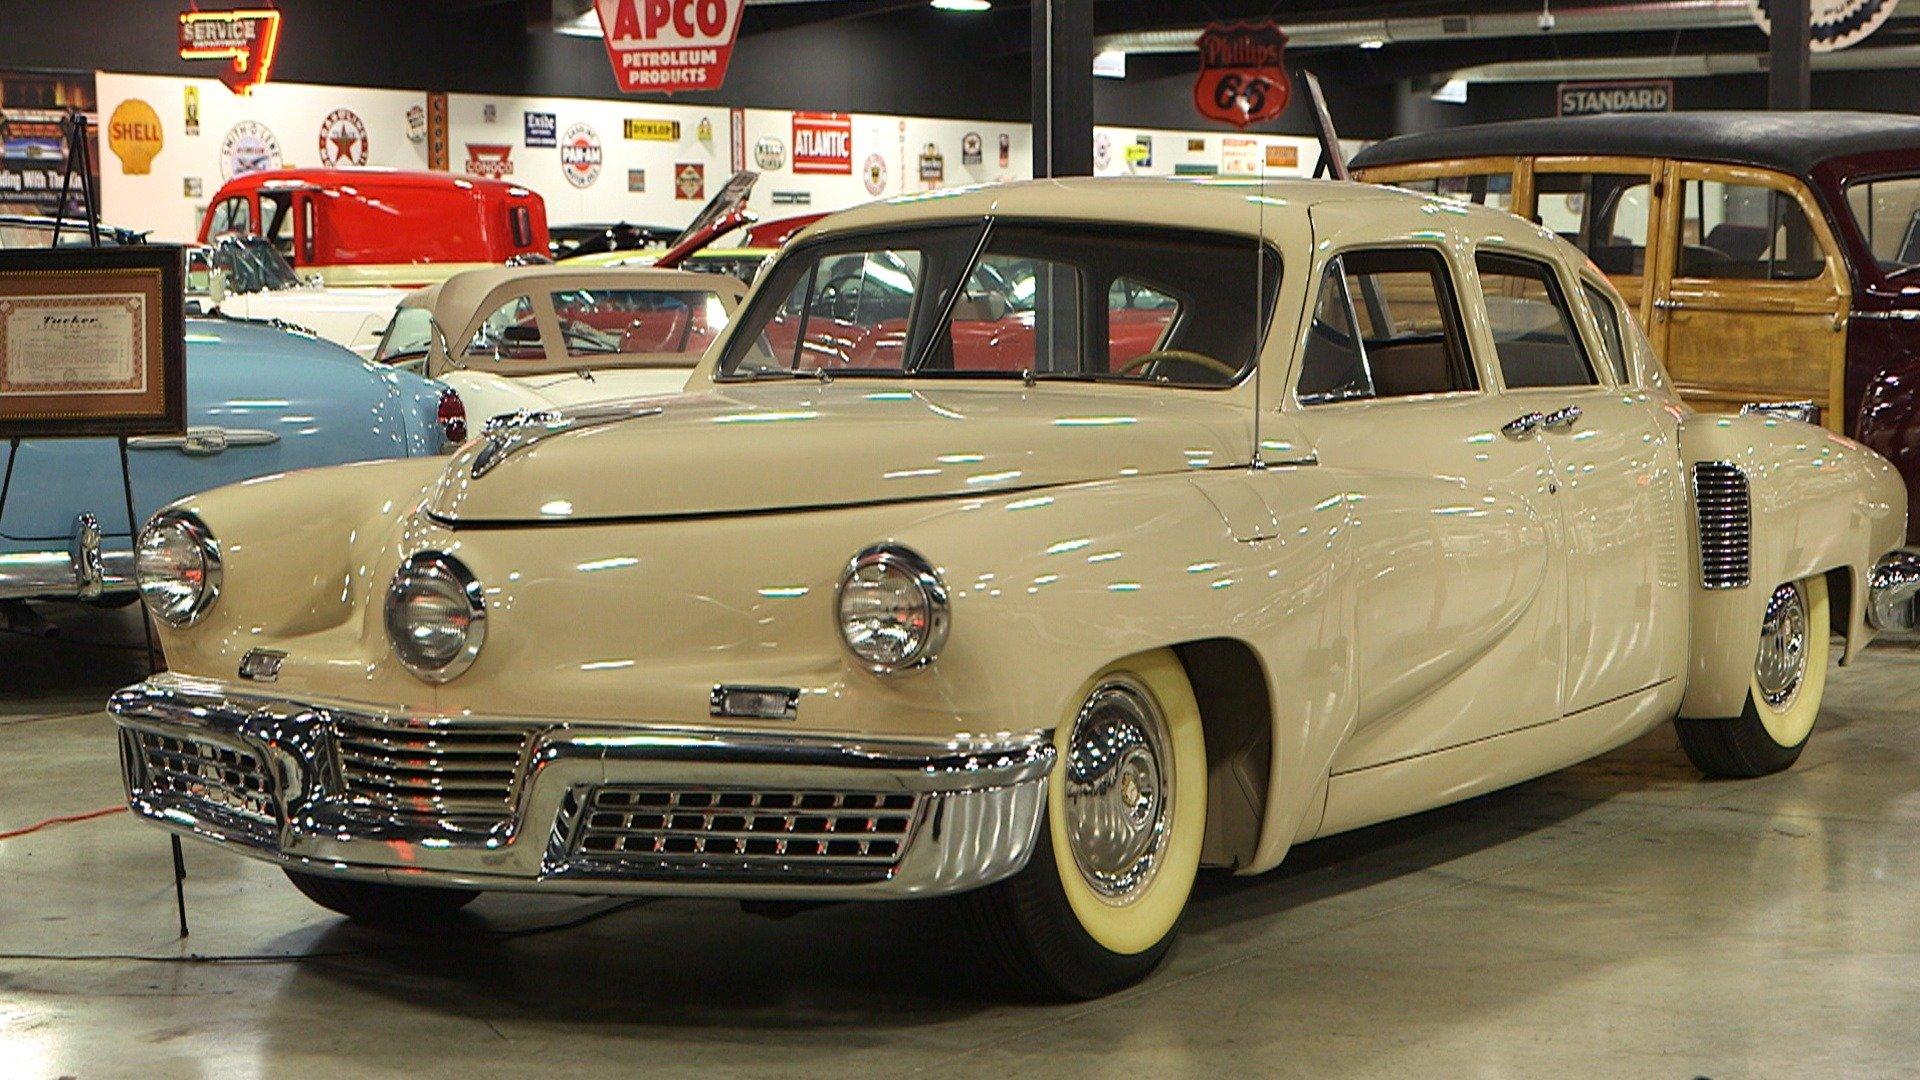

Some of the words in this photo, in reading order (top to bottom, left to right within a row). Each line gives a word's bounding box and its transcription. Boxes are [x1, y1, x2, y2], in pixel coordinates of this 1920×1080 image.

[184, 20, 256, 40] SERVICE
[612, 0, 727, 41] APCO
[622, 50, 717, 68] PETROLEUM
[1206, 36, 1279, 66] Phillips
[629, 68, 707, 85] PRODUCTS
[1215, 73, 1269, 113] 66
[1562, 88, 1667, 113] STANDARD
[112, 129, 161, 142] SHELL
[633, 123, 672, 136] DUNLOP
[795, 129, 850, 158] ATLANTIC
[43, 314, 98, 324] Tucker
